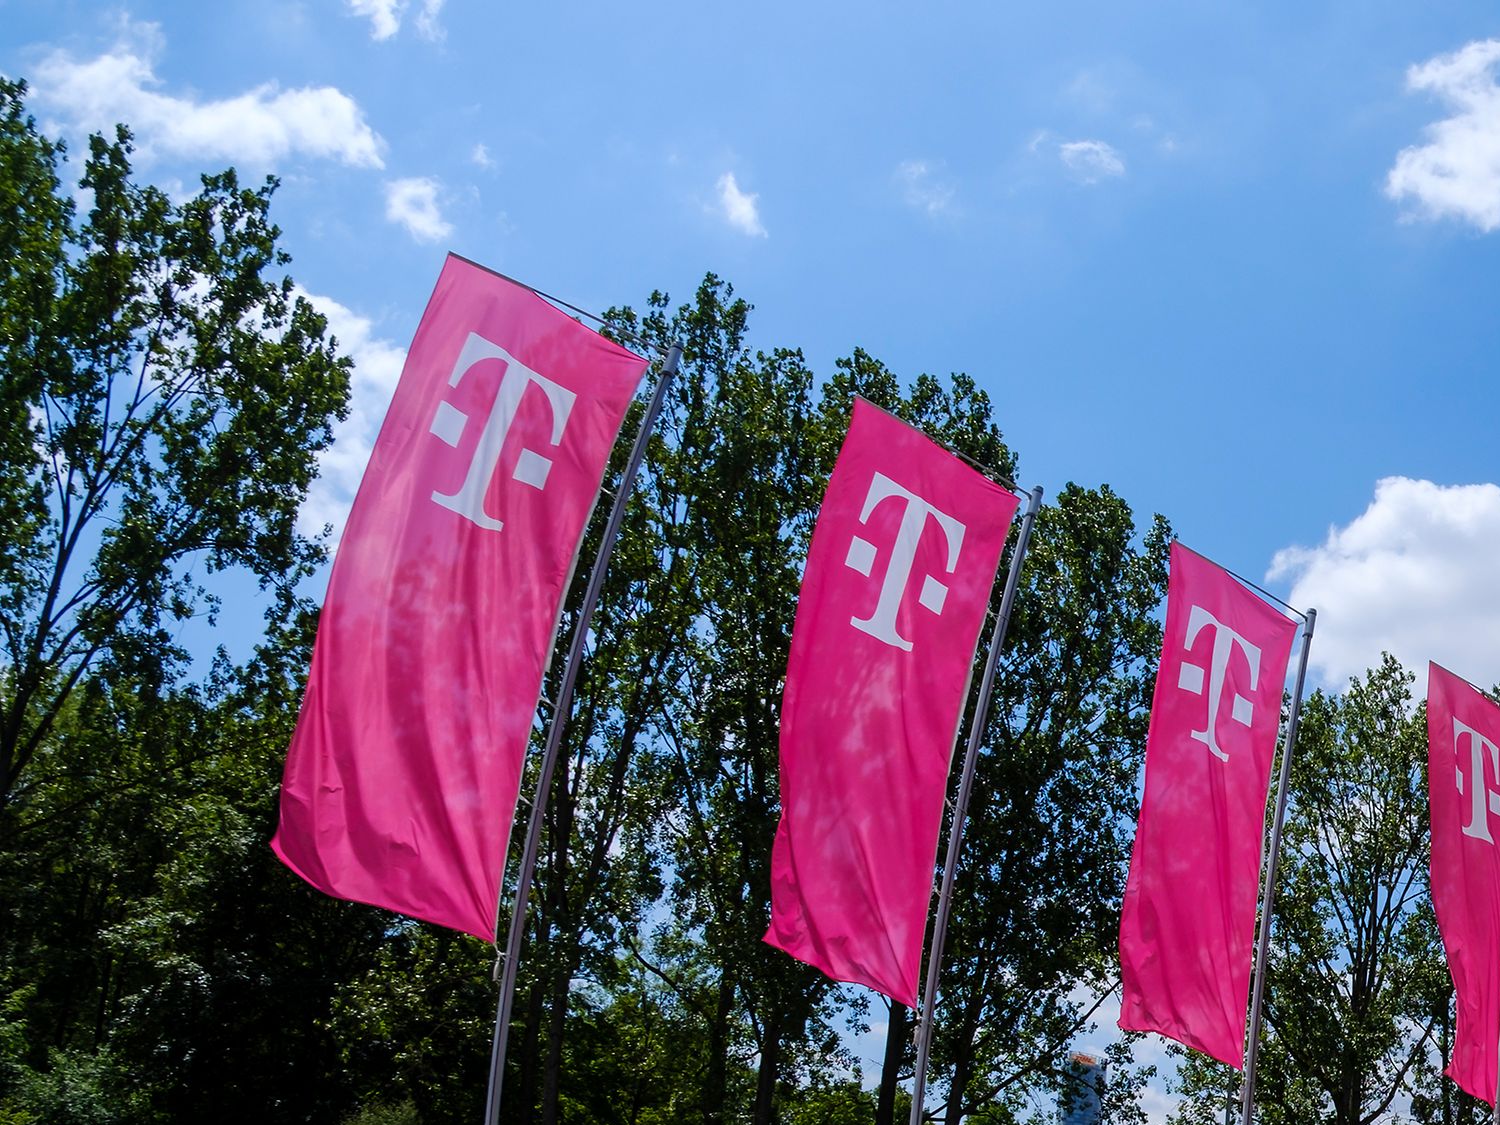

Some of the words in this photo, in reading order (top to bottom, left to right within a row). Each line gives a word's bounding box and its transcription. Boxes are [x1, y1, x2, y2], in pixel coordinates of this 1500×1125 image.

[430, 332, 577, 531] T
[845, 472, 966, 652] T
[1178, 605, 1261, 762] T
